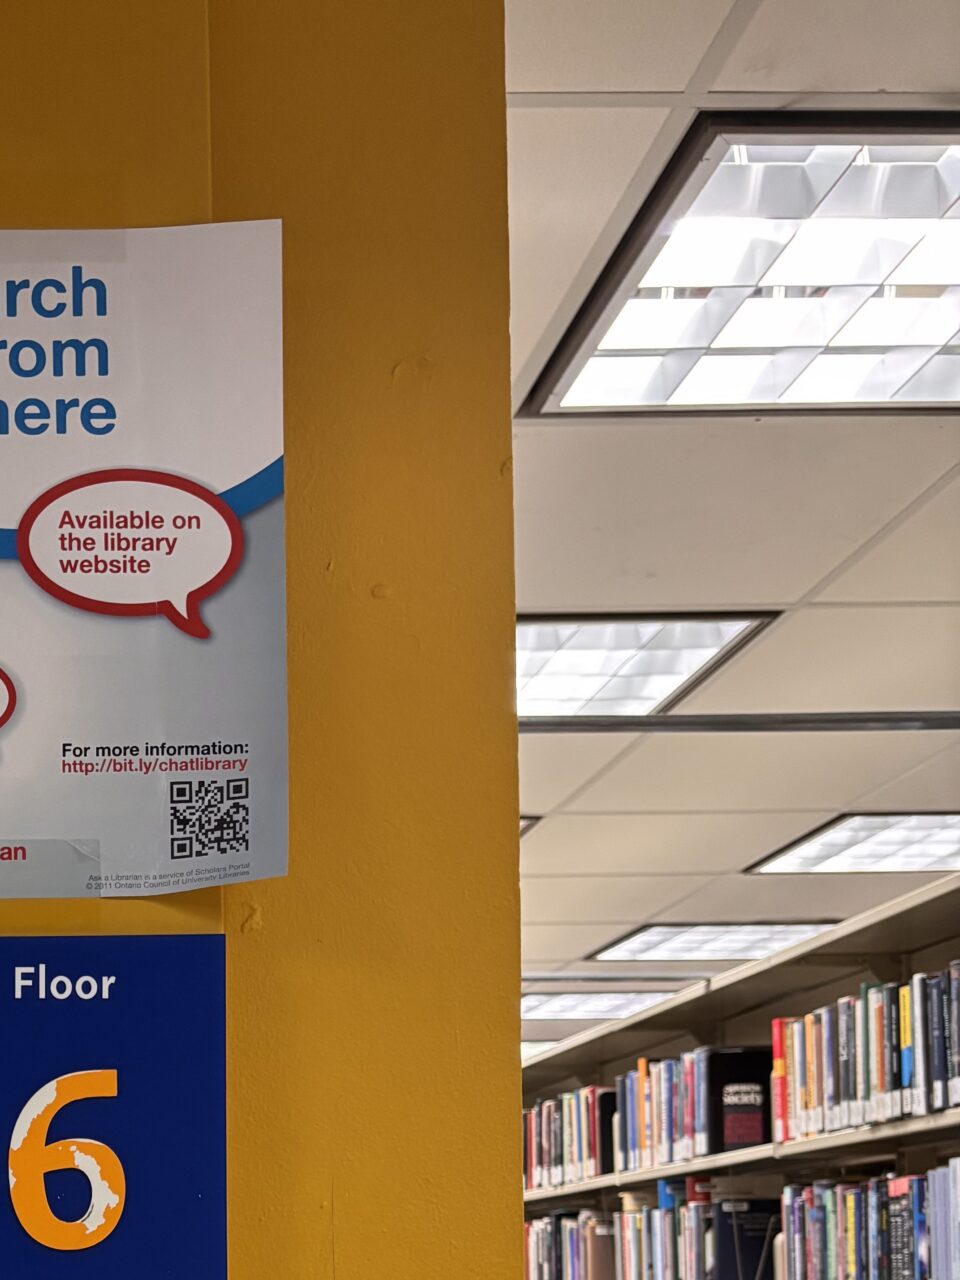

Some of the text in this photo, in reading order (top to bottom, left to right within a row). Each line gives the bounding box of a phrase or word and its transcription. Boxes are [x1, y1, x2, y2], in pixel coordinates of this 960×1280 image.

[58, 509, 202, 530] Available on
[58, 533, 178, 556] the library
[58, 556, 152, 574] website
[62, 741, 249, 757] For more information:
[61, 758, 249, 775] http://bit.ly/chatlibrary
[88, 874, 103, 882] Ask
[110, 873, 143, 882] Librarian
[158, 871, 185, 881] service
[186, 869, 194, 877] of
[195, 865, 227, 876] Scholars
[228, 862, 250, 872] Portal
[94, 881, 112, 890] 2011
[114, 880, 142, 890] Ontario
[143, 879, 171, 889] Council
[172, 878, 180, 886] of
[181, 873, 217, 886] University
[218, 870, 250, 880] Libraries
[14, 964, 117, 1000] Floor
[9, 1068, 127, 1251] 6
